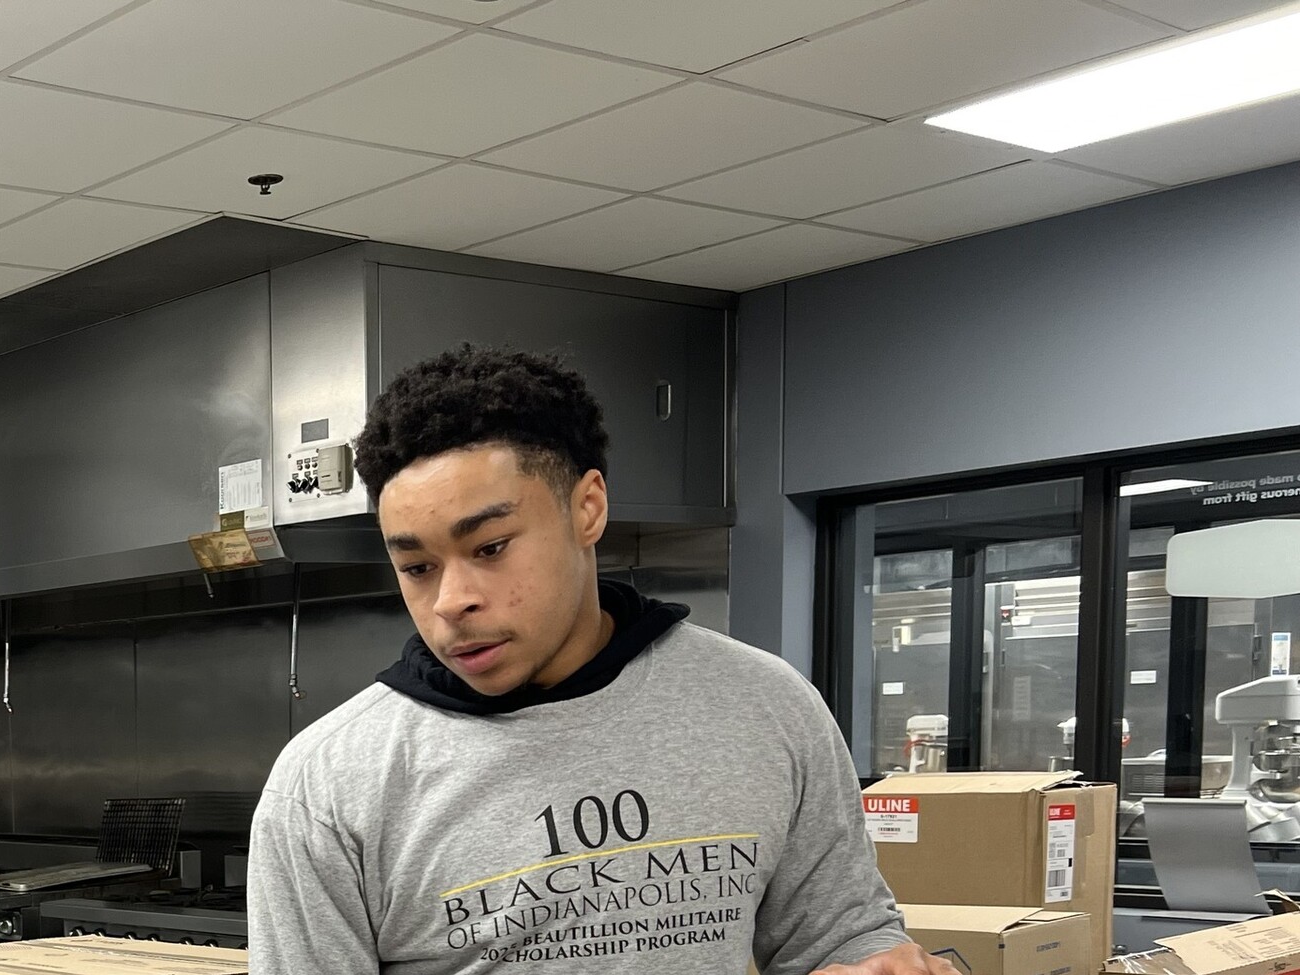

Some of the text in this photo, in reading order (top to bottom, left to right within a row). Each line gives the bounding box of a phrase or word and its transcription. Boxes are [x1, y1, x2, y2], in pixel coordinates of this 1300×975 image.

[534, 789, 650, 858] 100
[867, 798, 911, 812] ULINE
[443, 842, 758, 926] BLACK MEN
[447, 921, 481, 950] OF
[502, 928, 727, 963] CHOLARSHIP PROGRAM
[522, 918, 650, 947] BEAUTILLION
[655, 907, 742, 932] MILITAIRE
